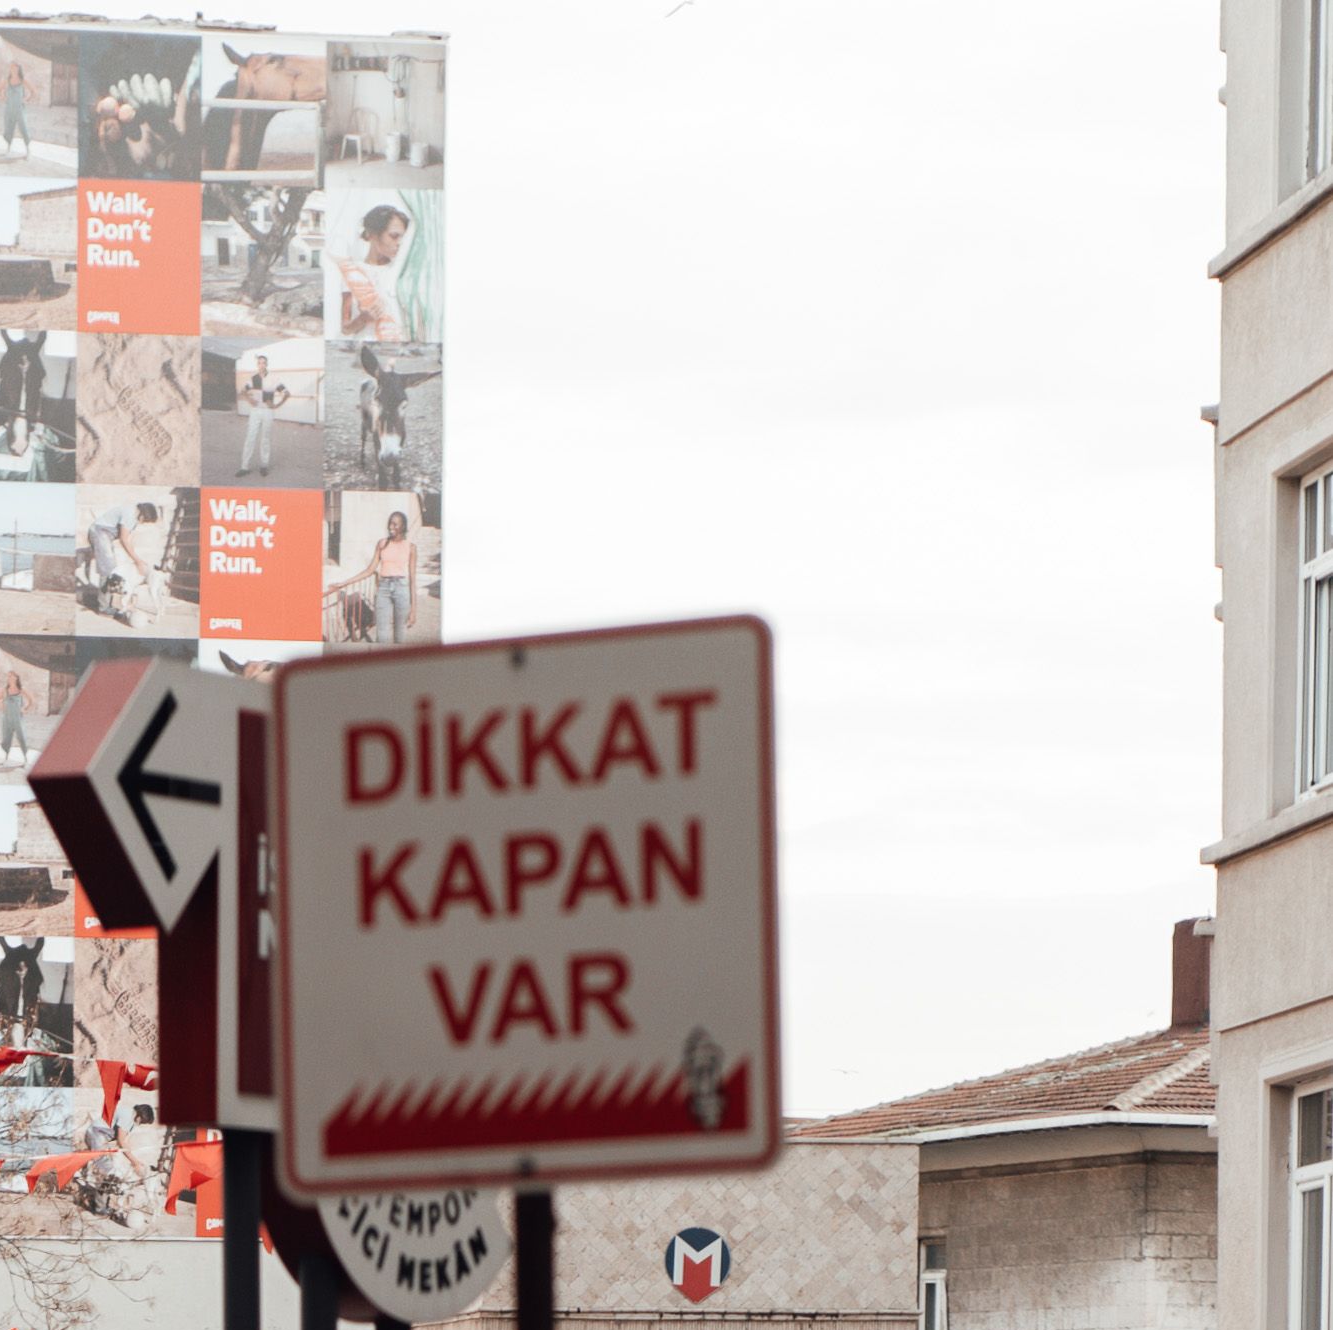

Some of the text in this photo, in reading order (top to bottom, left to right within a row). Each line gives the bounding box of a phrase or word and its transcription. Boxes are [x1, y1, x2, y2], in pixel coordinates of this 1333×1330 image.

[86, 191, 155, 218] Walk,
[87, 217, 152, 243] Don't
[87, 243, 140, 268] Run.
[209, 498, 277, 525] Walk,
[210, 525, 274, 549] Don't
[210, 551, 263, 574] Run.
[345, 691, 717, 806] DİKKAT
[357, 815, 703, 931] KAPAN
[427, 951, 634, 1048] VAR
